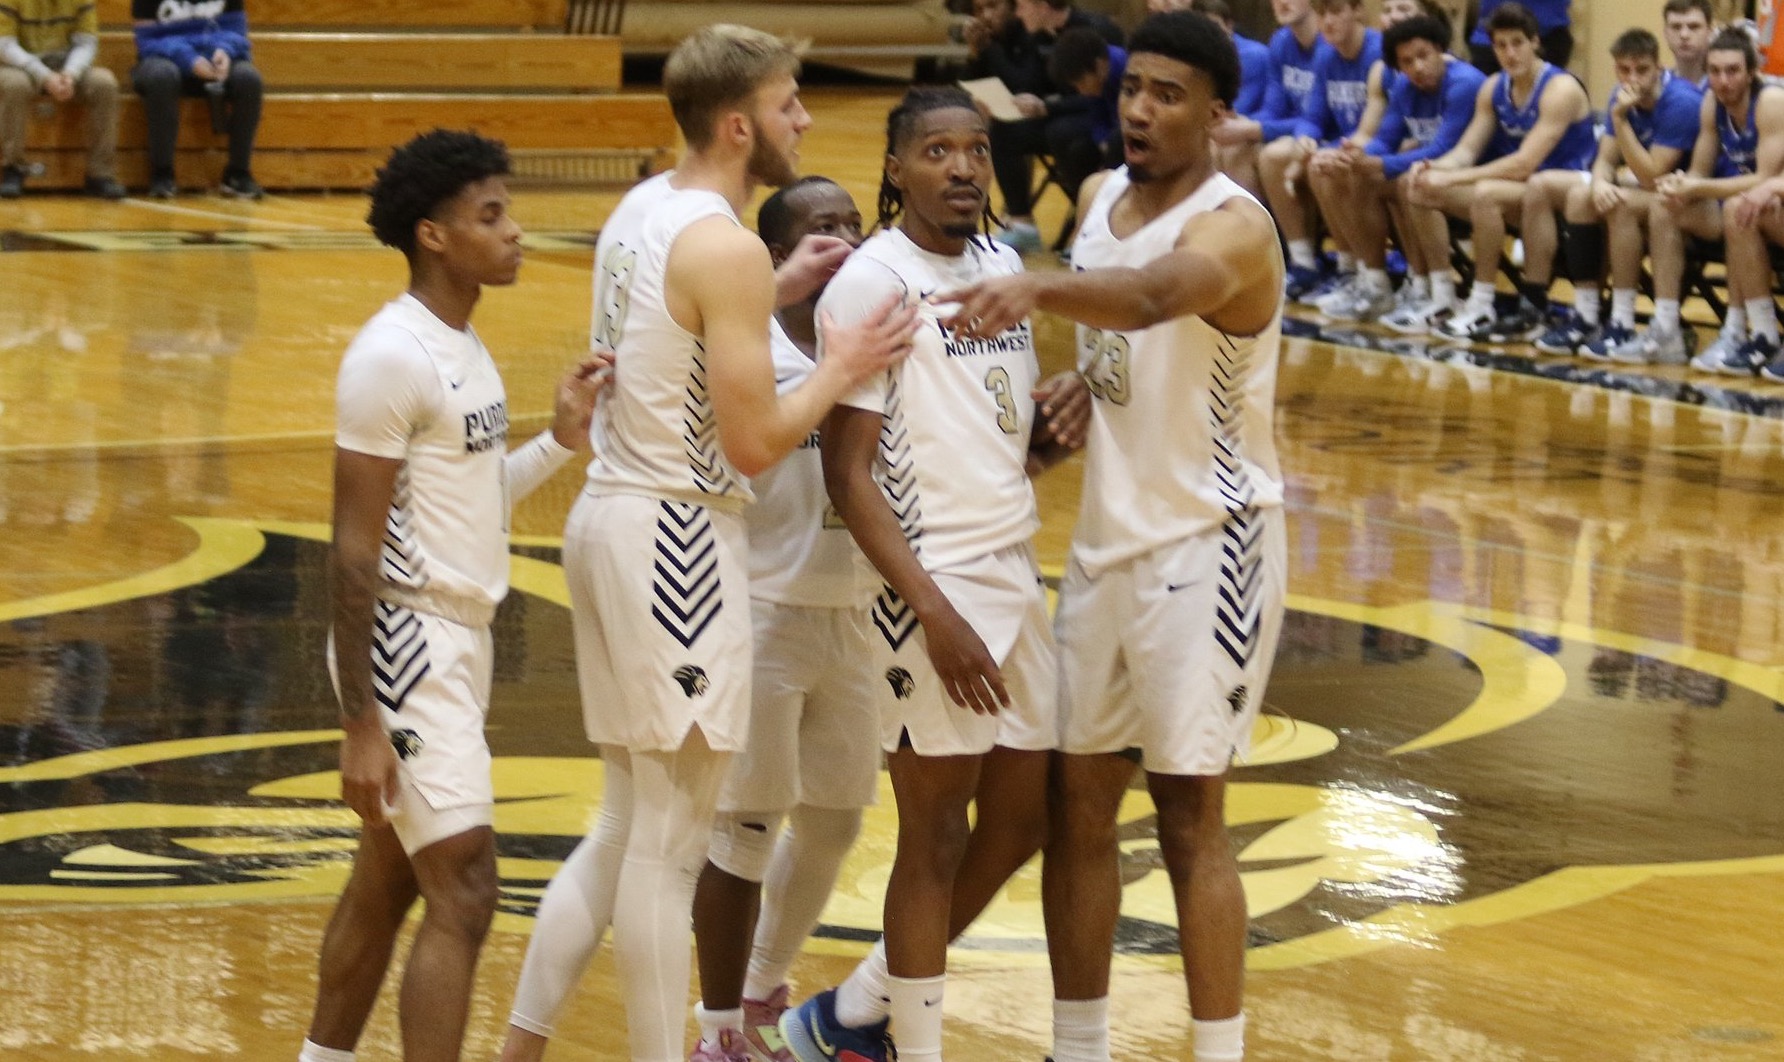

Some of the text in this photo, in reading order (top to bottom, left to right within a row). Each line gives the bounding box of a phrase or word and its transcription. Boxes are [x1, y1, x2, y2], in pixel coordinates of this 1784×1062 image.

[945, 333, 1031, 357] NORTHWEST
[1085, 326, 1131, 406] 23
[985, 366, 1018, 435] 3
